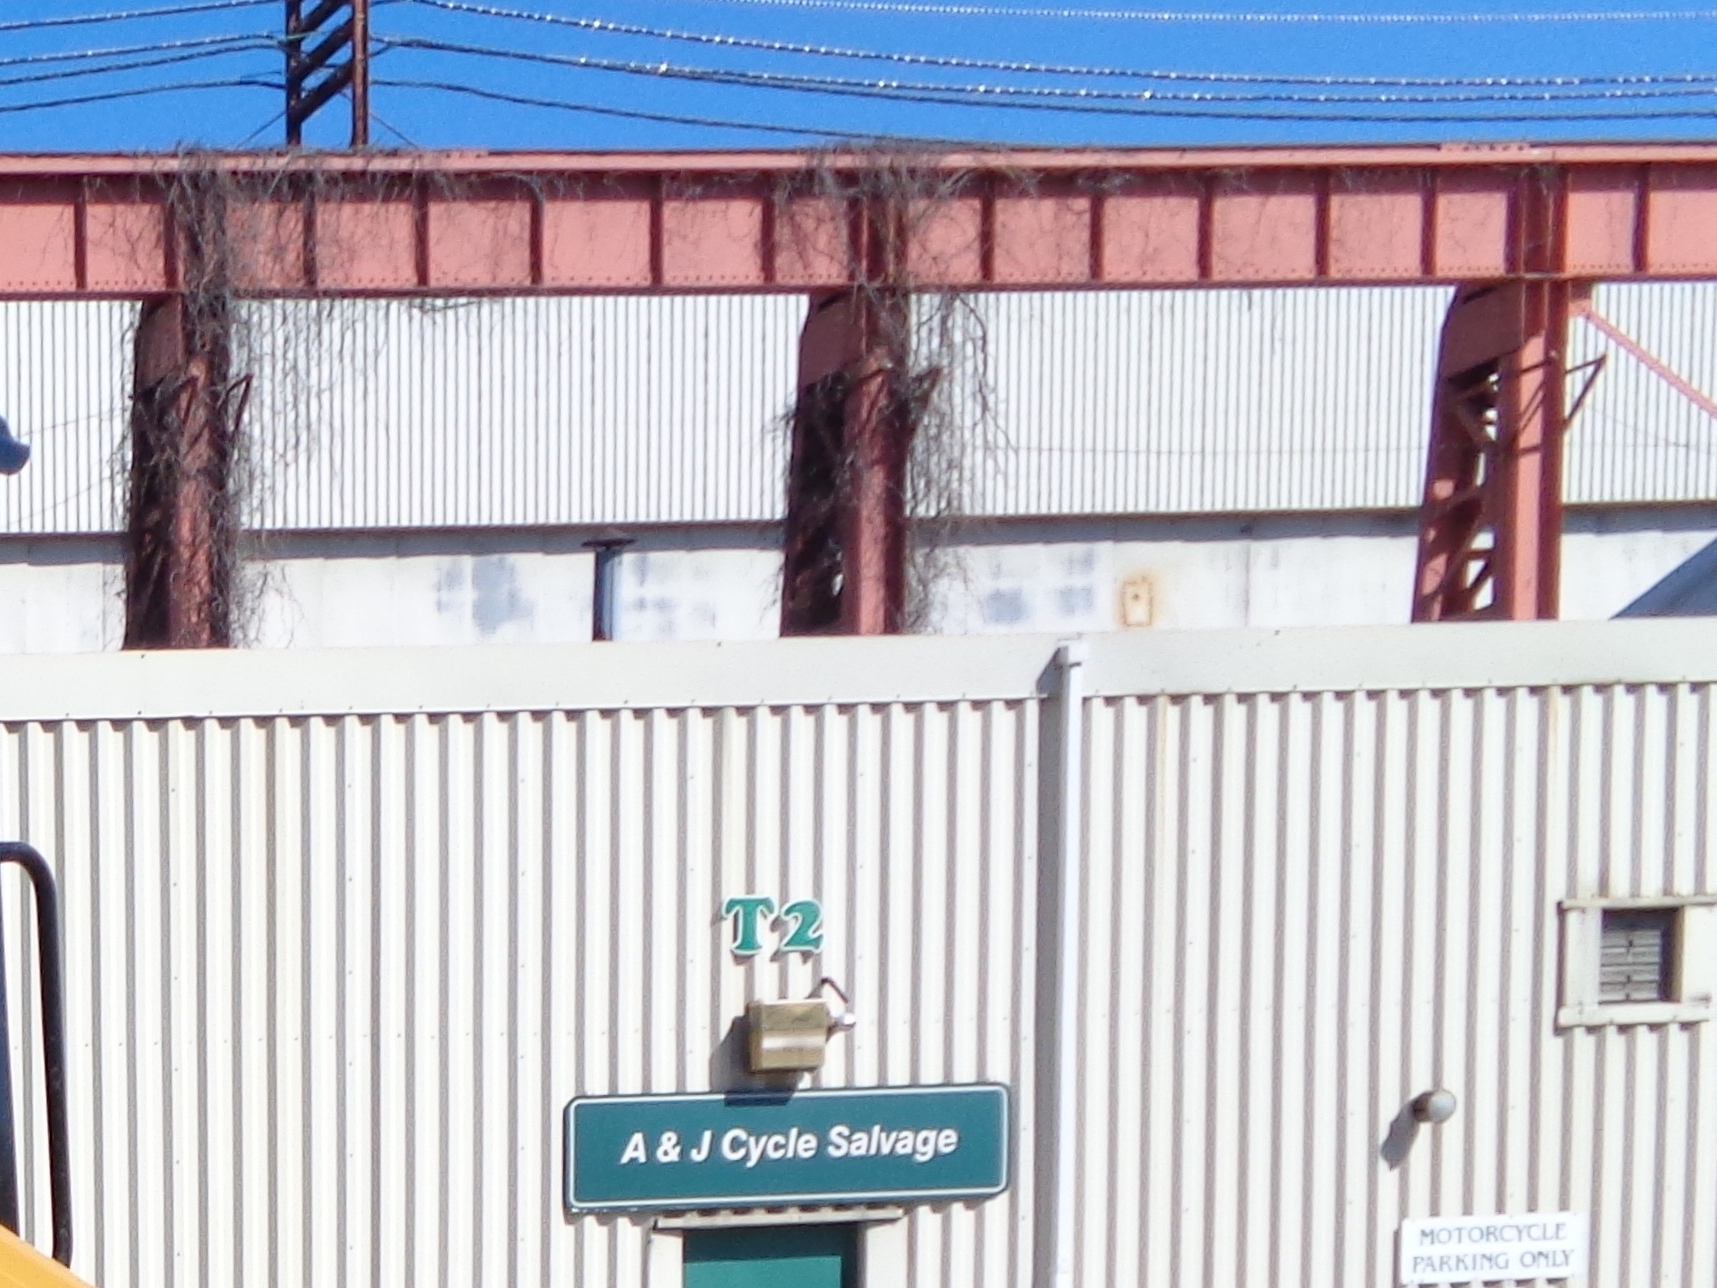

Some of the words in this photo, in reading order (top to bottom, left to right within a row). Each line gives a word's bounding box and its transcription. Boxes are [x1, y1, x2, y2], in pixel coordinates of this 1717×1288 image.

[620, 1132, 647, 1164] A
[655, 1130, 681, 1161] &
[690, 1130, 712, 1161] J
[721, 1127, 818, 1168] Cycle
[827, 1123, 958, 1163] Salvage
[1420, 1223, 1567, 1246] MOTORCYCLE
[1412, 1252, 1509, 1273] PARKING
[1520, 1249, 1575, 1268] ONLY
